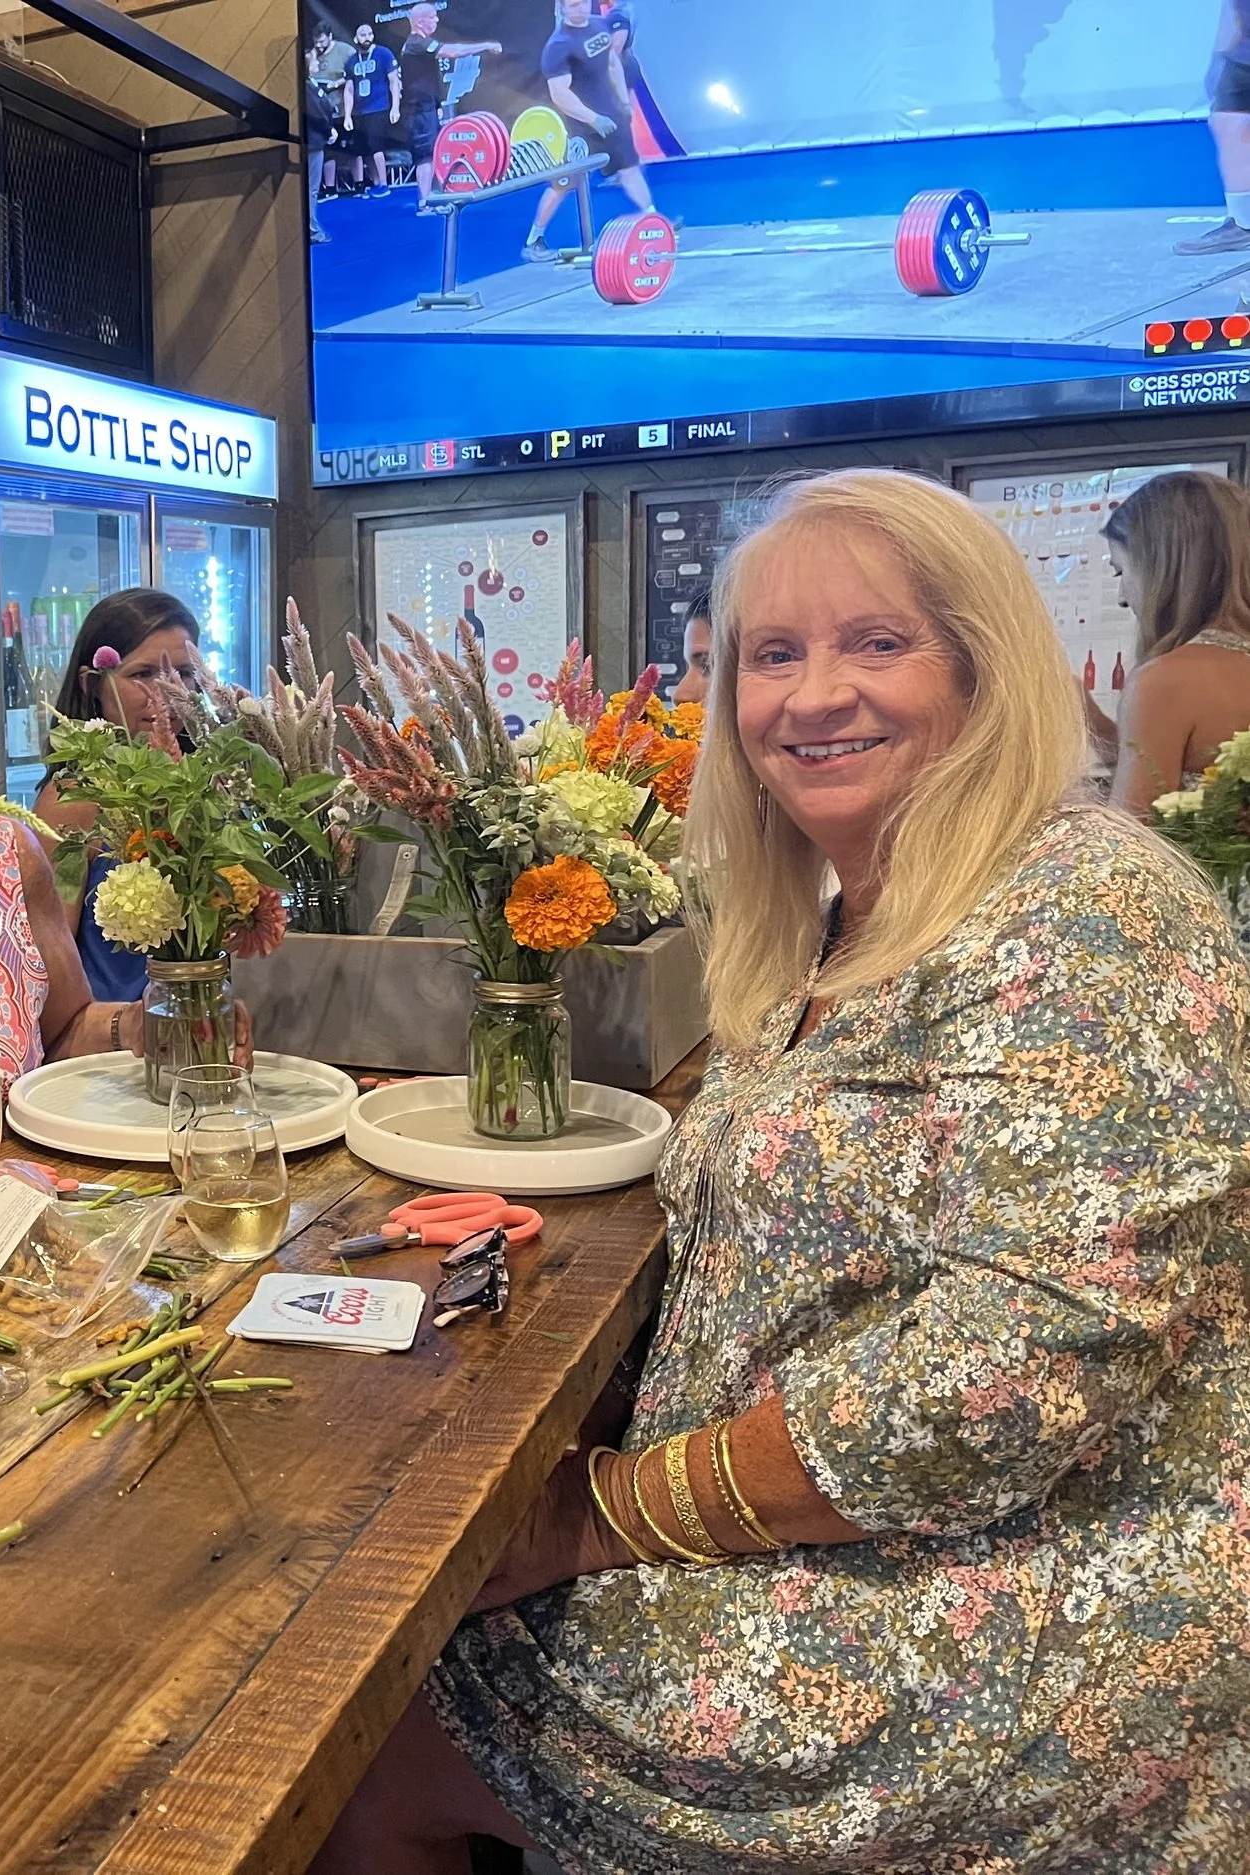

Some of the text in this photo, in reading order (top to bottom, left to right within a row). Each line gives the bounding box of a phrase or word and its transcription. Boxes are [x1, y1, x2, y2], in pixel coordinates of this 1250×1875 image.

[1144, 369, 1250, 392] CBS SPORTS
[1144, 386, 1237, 407] NETWORK
[379, 453, 407, 468] MLB
[461, 445, 485, 460] STL
[521, 441, 533, 456] 0
[582, 434, 606, 449] PIT
[647, 429, 658, 444] 5
[688, 423, 736, 441] FINAL
[1003, 482, 1064, 501] BASIC
[323, 1287, 369, 1326] Coors
[364, 1294, 388, 1321] LIGHT
